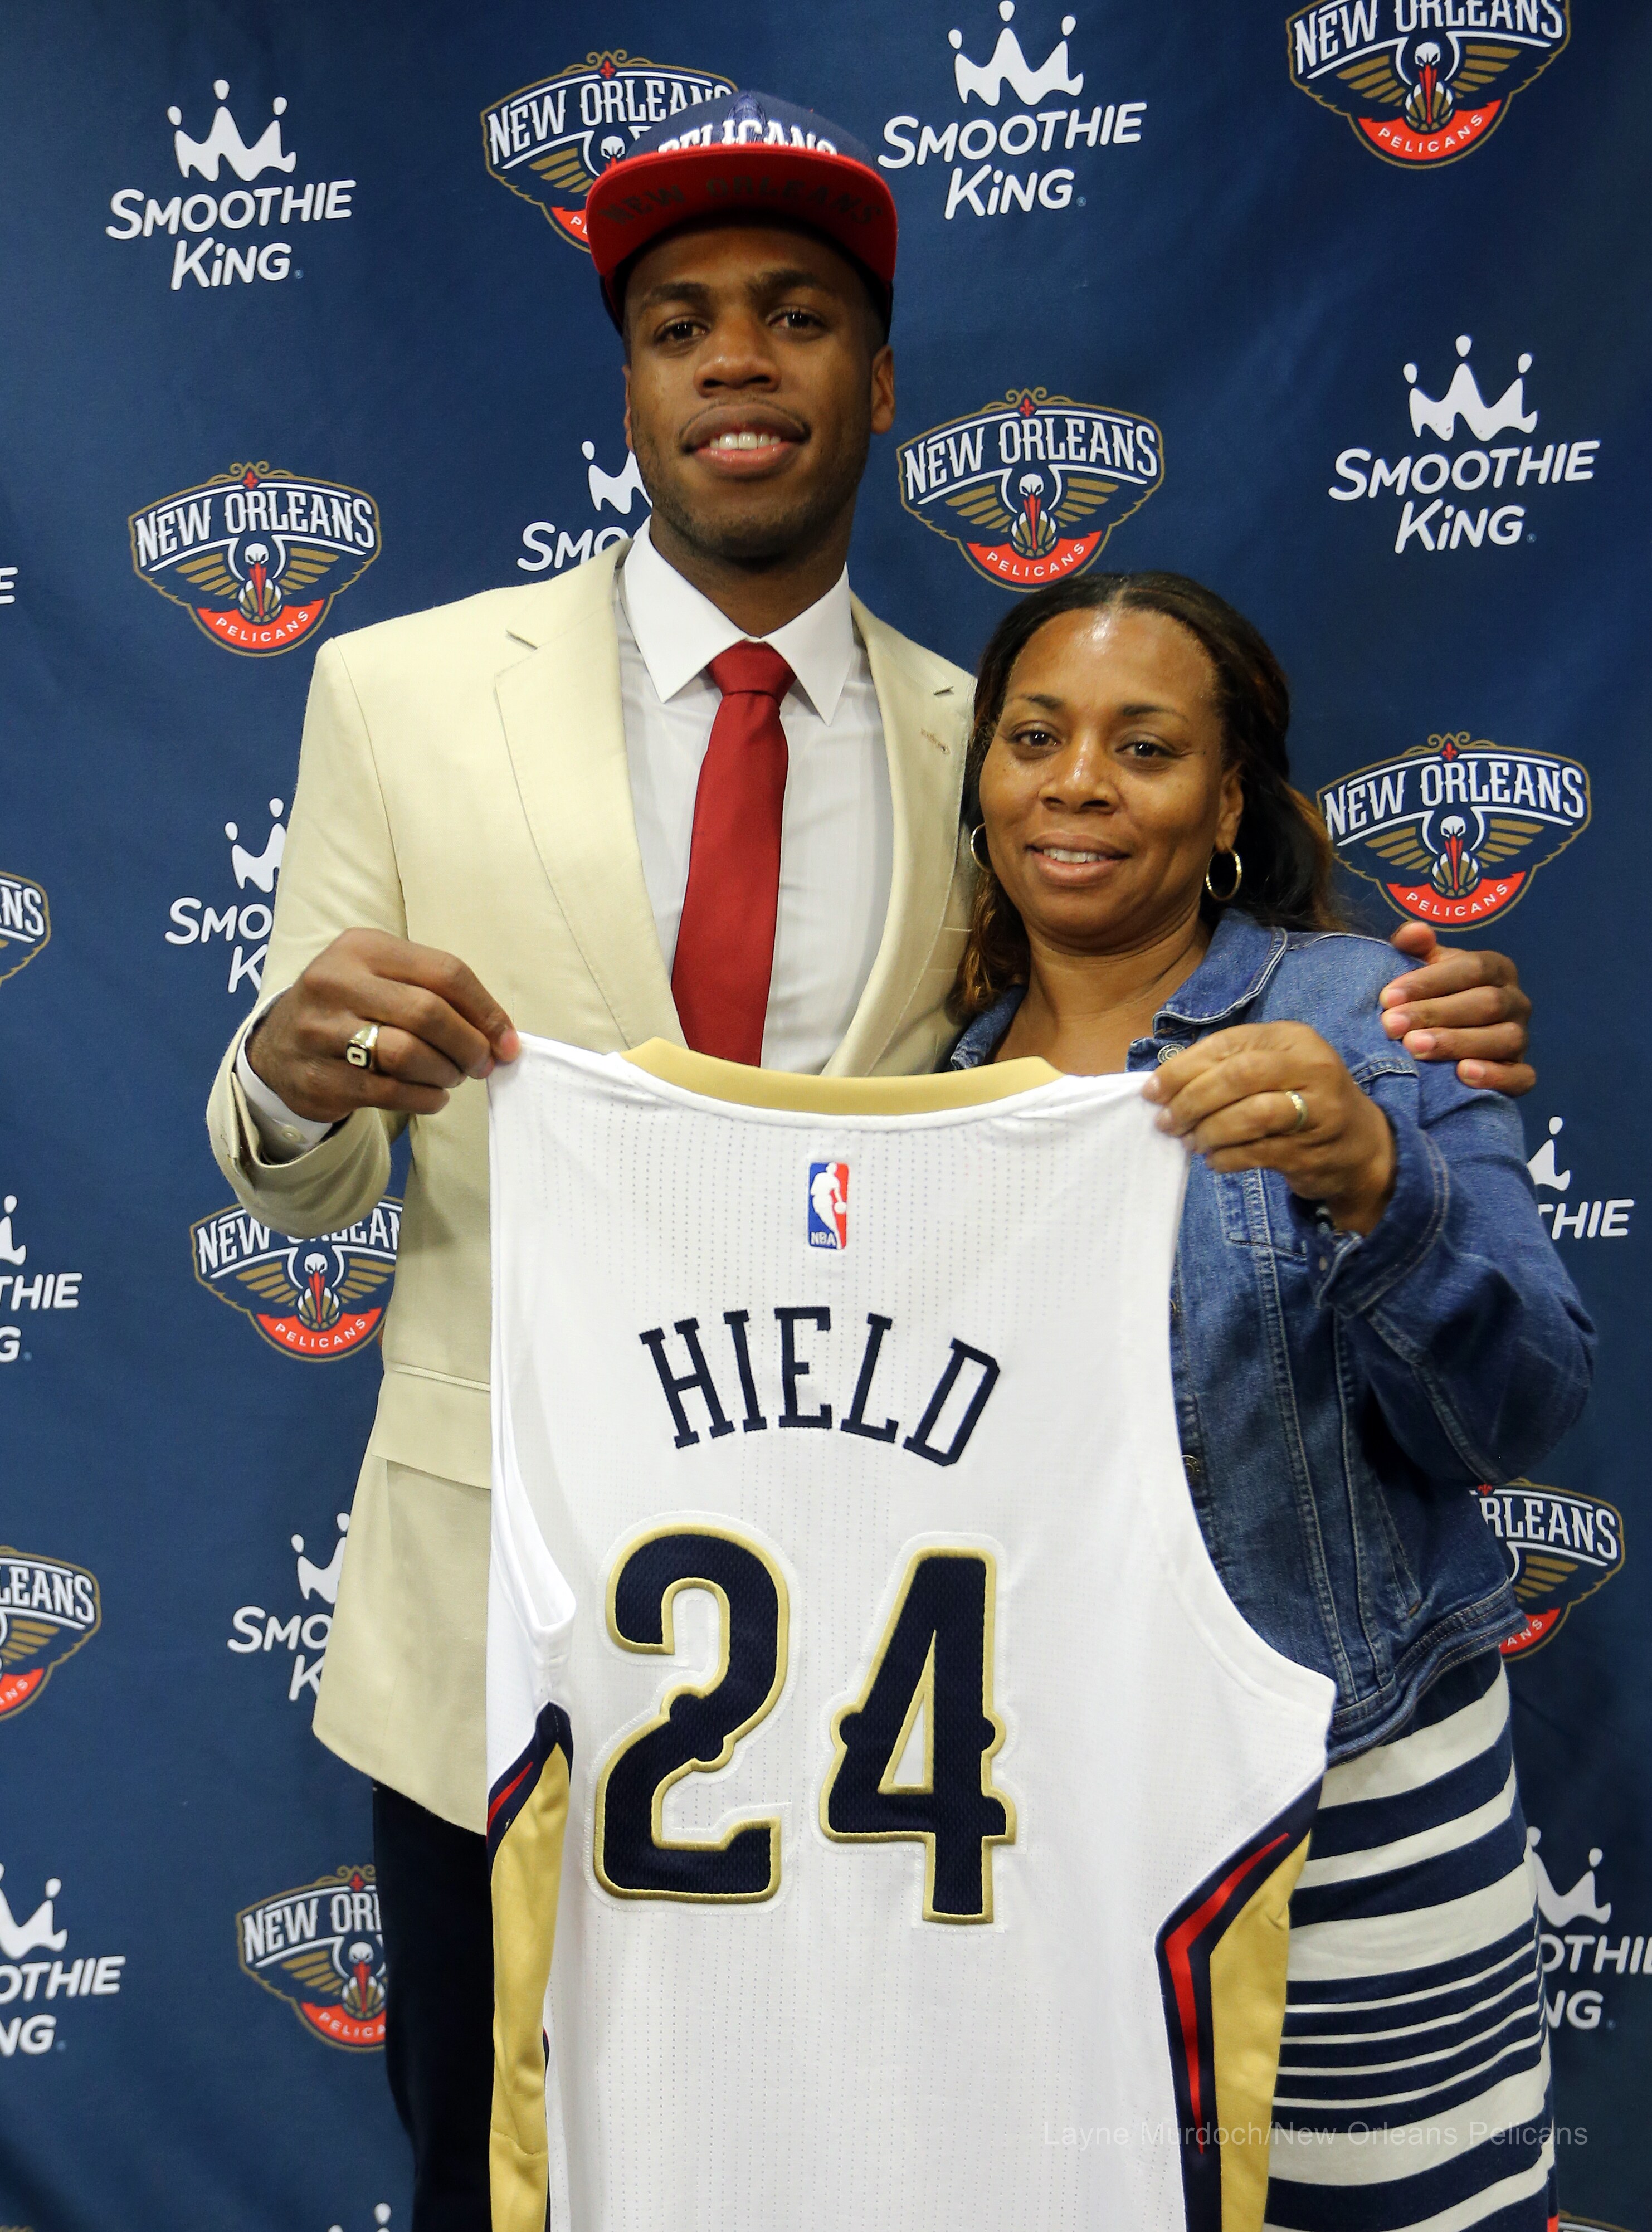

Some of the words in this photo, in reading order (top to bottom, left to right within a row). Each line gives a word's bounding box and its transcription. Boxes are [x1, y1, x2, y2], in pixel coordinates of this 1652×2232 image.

[1294, 0, 1377, 75] NEW
[488, 89, 566, 165] NEW
[580, 79, 732, 126] ORLEA
[878, 101, 1147, 168] SMOOTHIE
[1378, 115, 1483, 152] PELICANS
[106, 180, 356, 240] SMOOTHIE
[598, 184, 685, 225] NEW
[705, 176, 883, 224] ORLEANS
[904, 427, 984, 500] NEW
[998, 418, 1157, 477] ORLEANS
[1328, 440, 1600, 500] SMOOTHIE
[135, 498, 212, 567] NEW
[225, 490, 375, 548] ORLEANS
[987, 543, 1085, 577] PELICANS
[216, 611, 309, 642] PELICANS
[1324, 771, 1406, 840] NEW
[1420, 761, 1584, 818] ORLEANS
[1406, 883, 1508, 917] PELICANS
[197, 1217, 270, 1274] NEW
[811, 1231, 836, 1246] NBA
[275, 1318, 366, 1348] PELICANS
[639, 1306, 1000, 1466] HIELD
[593, 1523, 1017, 1924] 24
[242, 1898, 319, 1963] NEW
